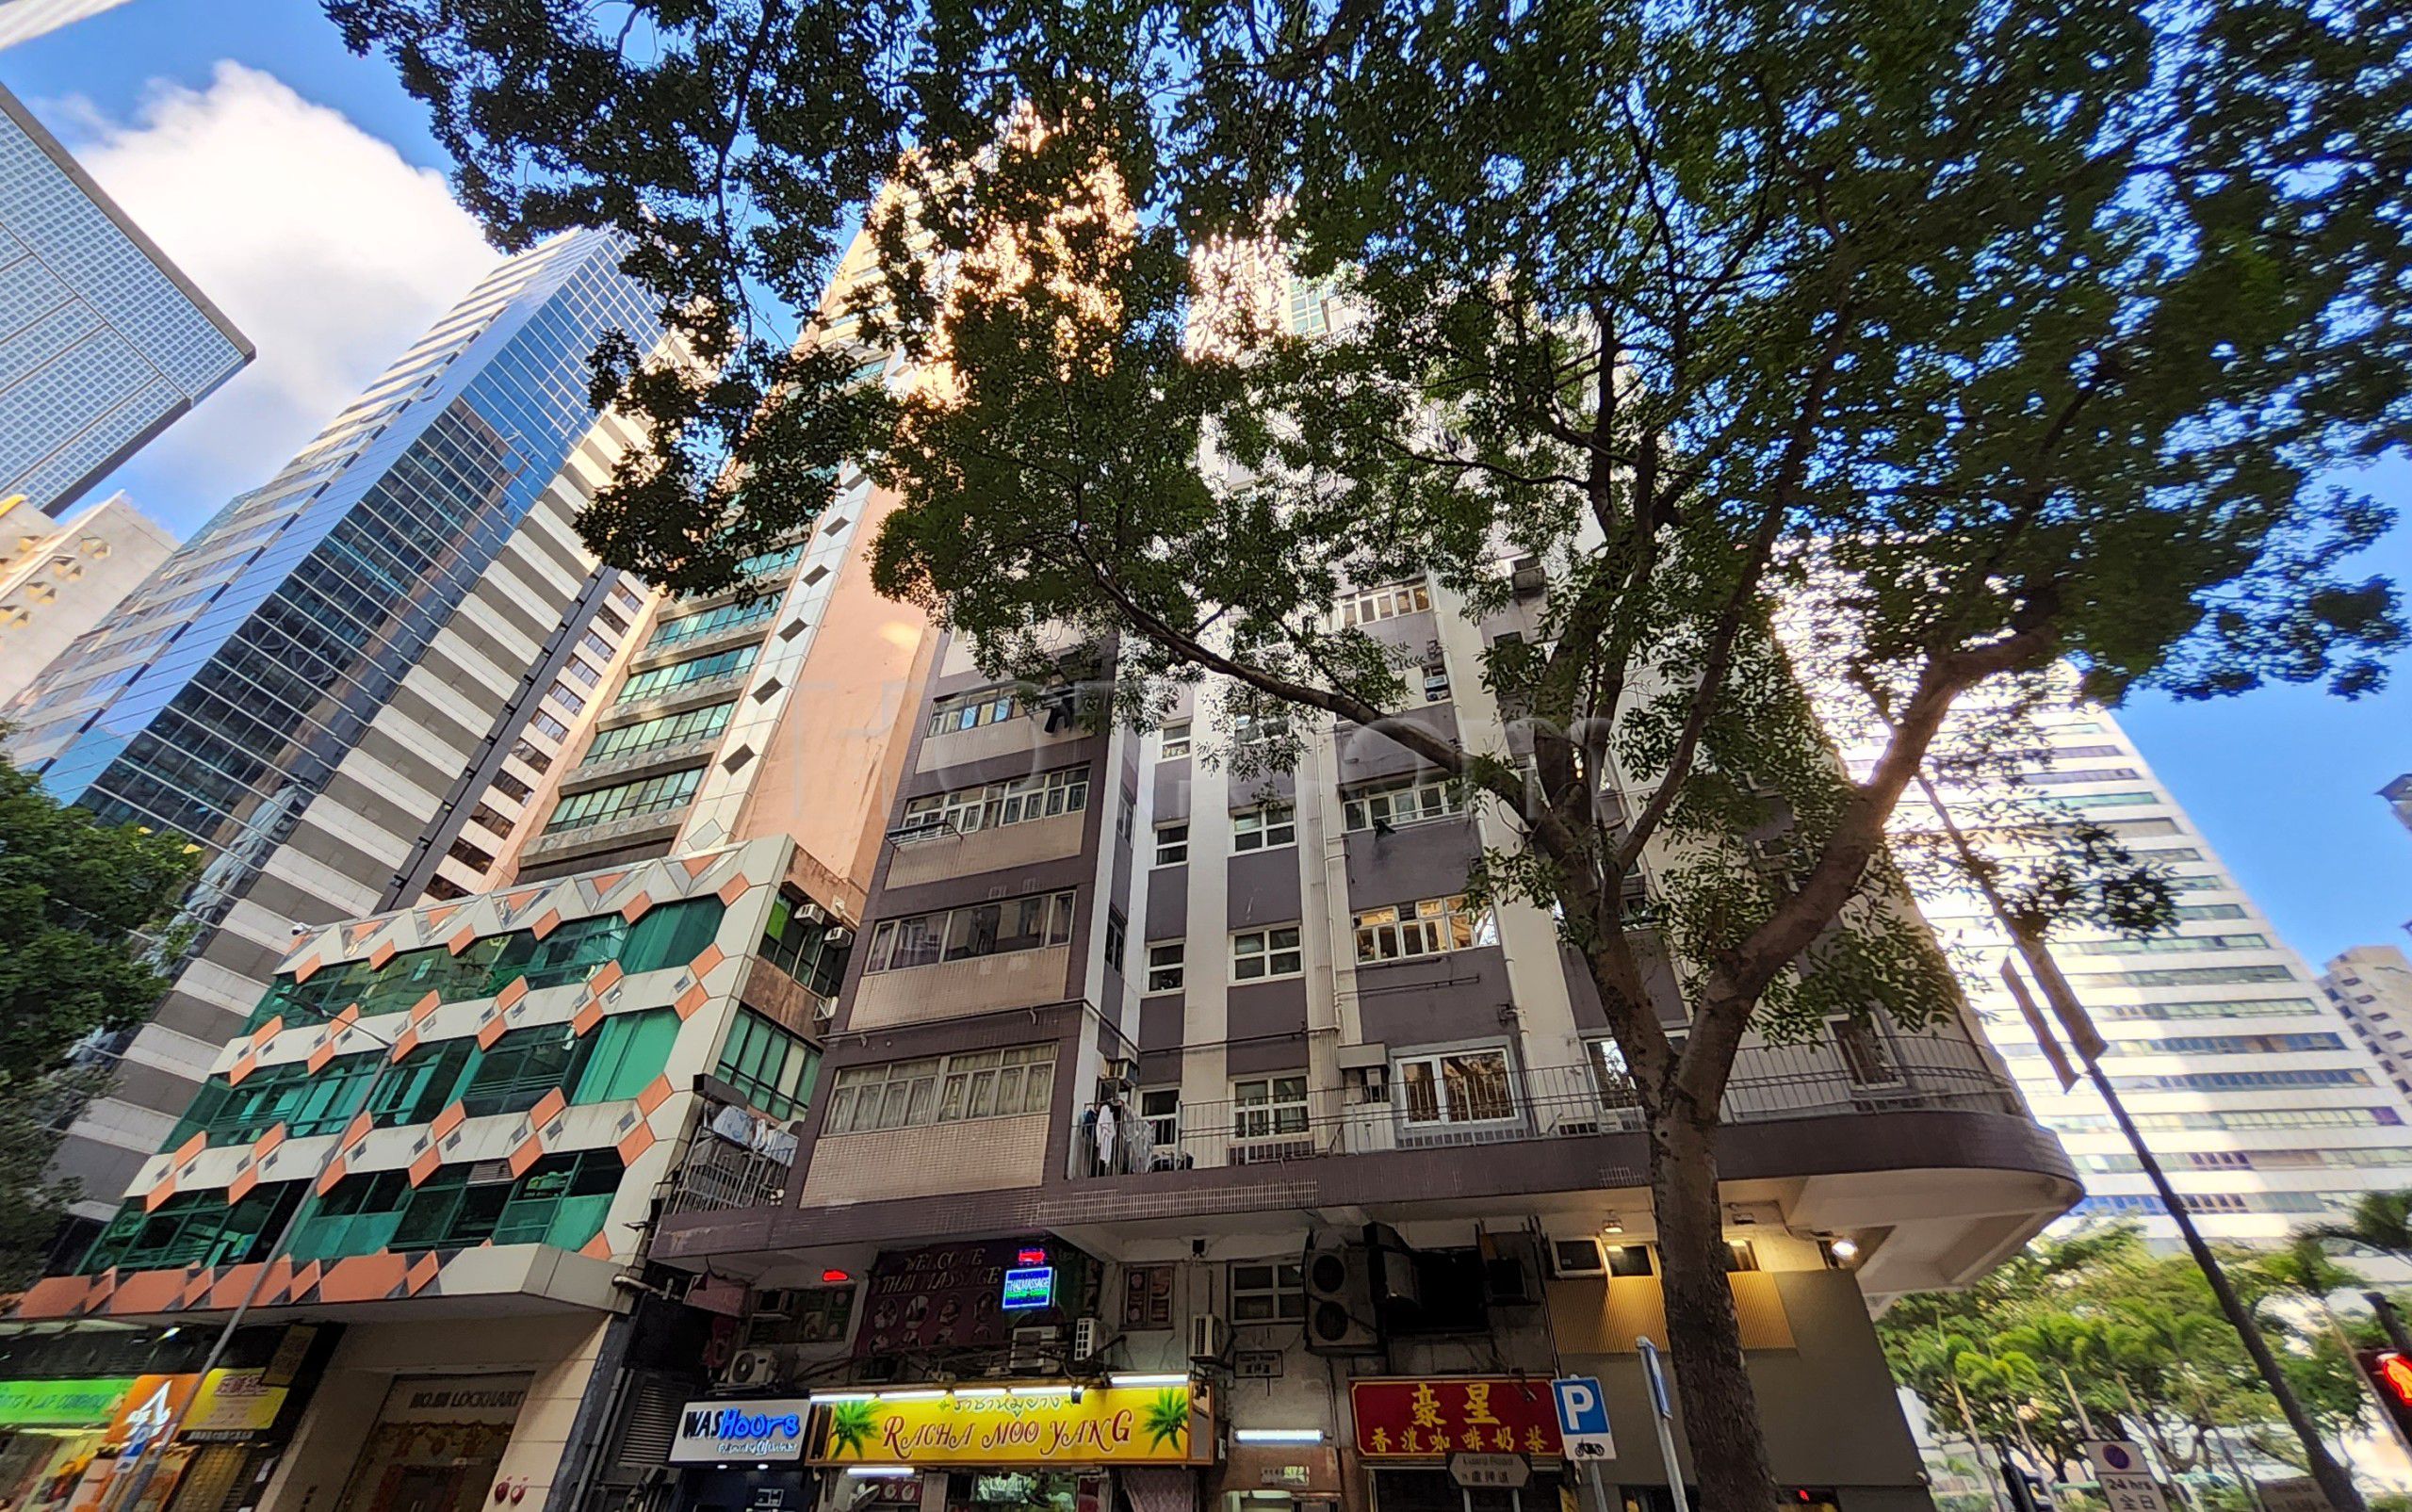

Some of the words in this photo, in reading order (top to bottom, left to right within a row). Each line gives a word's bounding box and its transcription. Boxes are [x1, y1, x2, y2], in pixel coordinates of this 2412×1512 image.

[882, 1274, 918, 1293] THAI
[1411, 1382, 1500, 1427] 豪星
[1560, 1384, 1594, 1430] P
[883, 1415, 976, 1459] RACHA
[982, 1420, 1040, 1449] MOO
[1039, 1409, 1133, 1456] YANG
[1370, 1425, 1549, 1453] 香濃咖啡奶茶
[2106, 1478, 2127, 1490] 24
[2127, 1479, 2153, 1490] hrs
[2119, 1494, 2157, 1510] 全日
